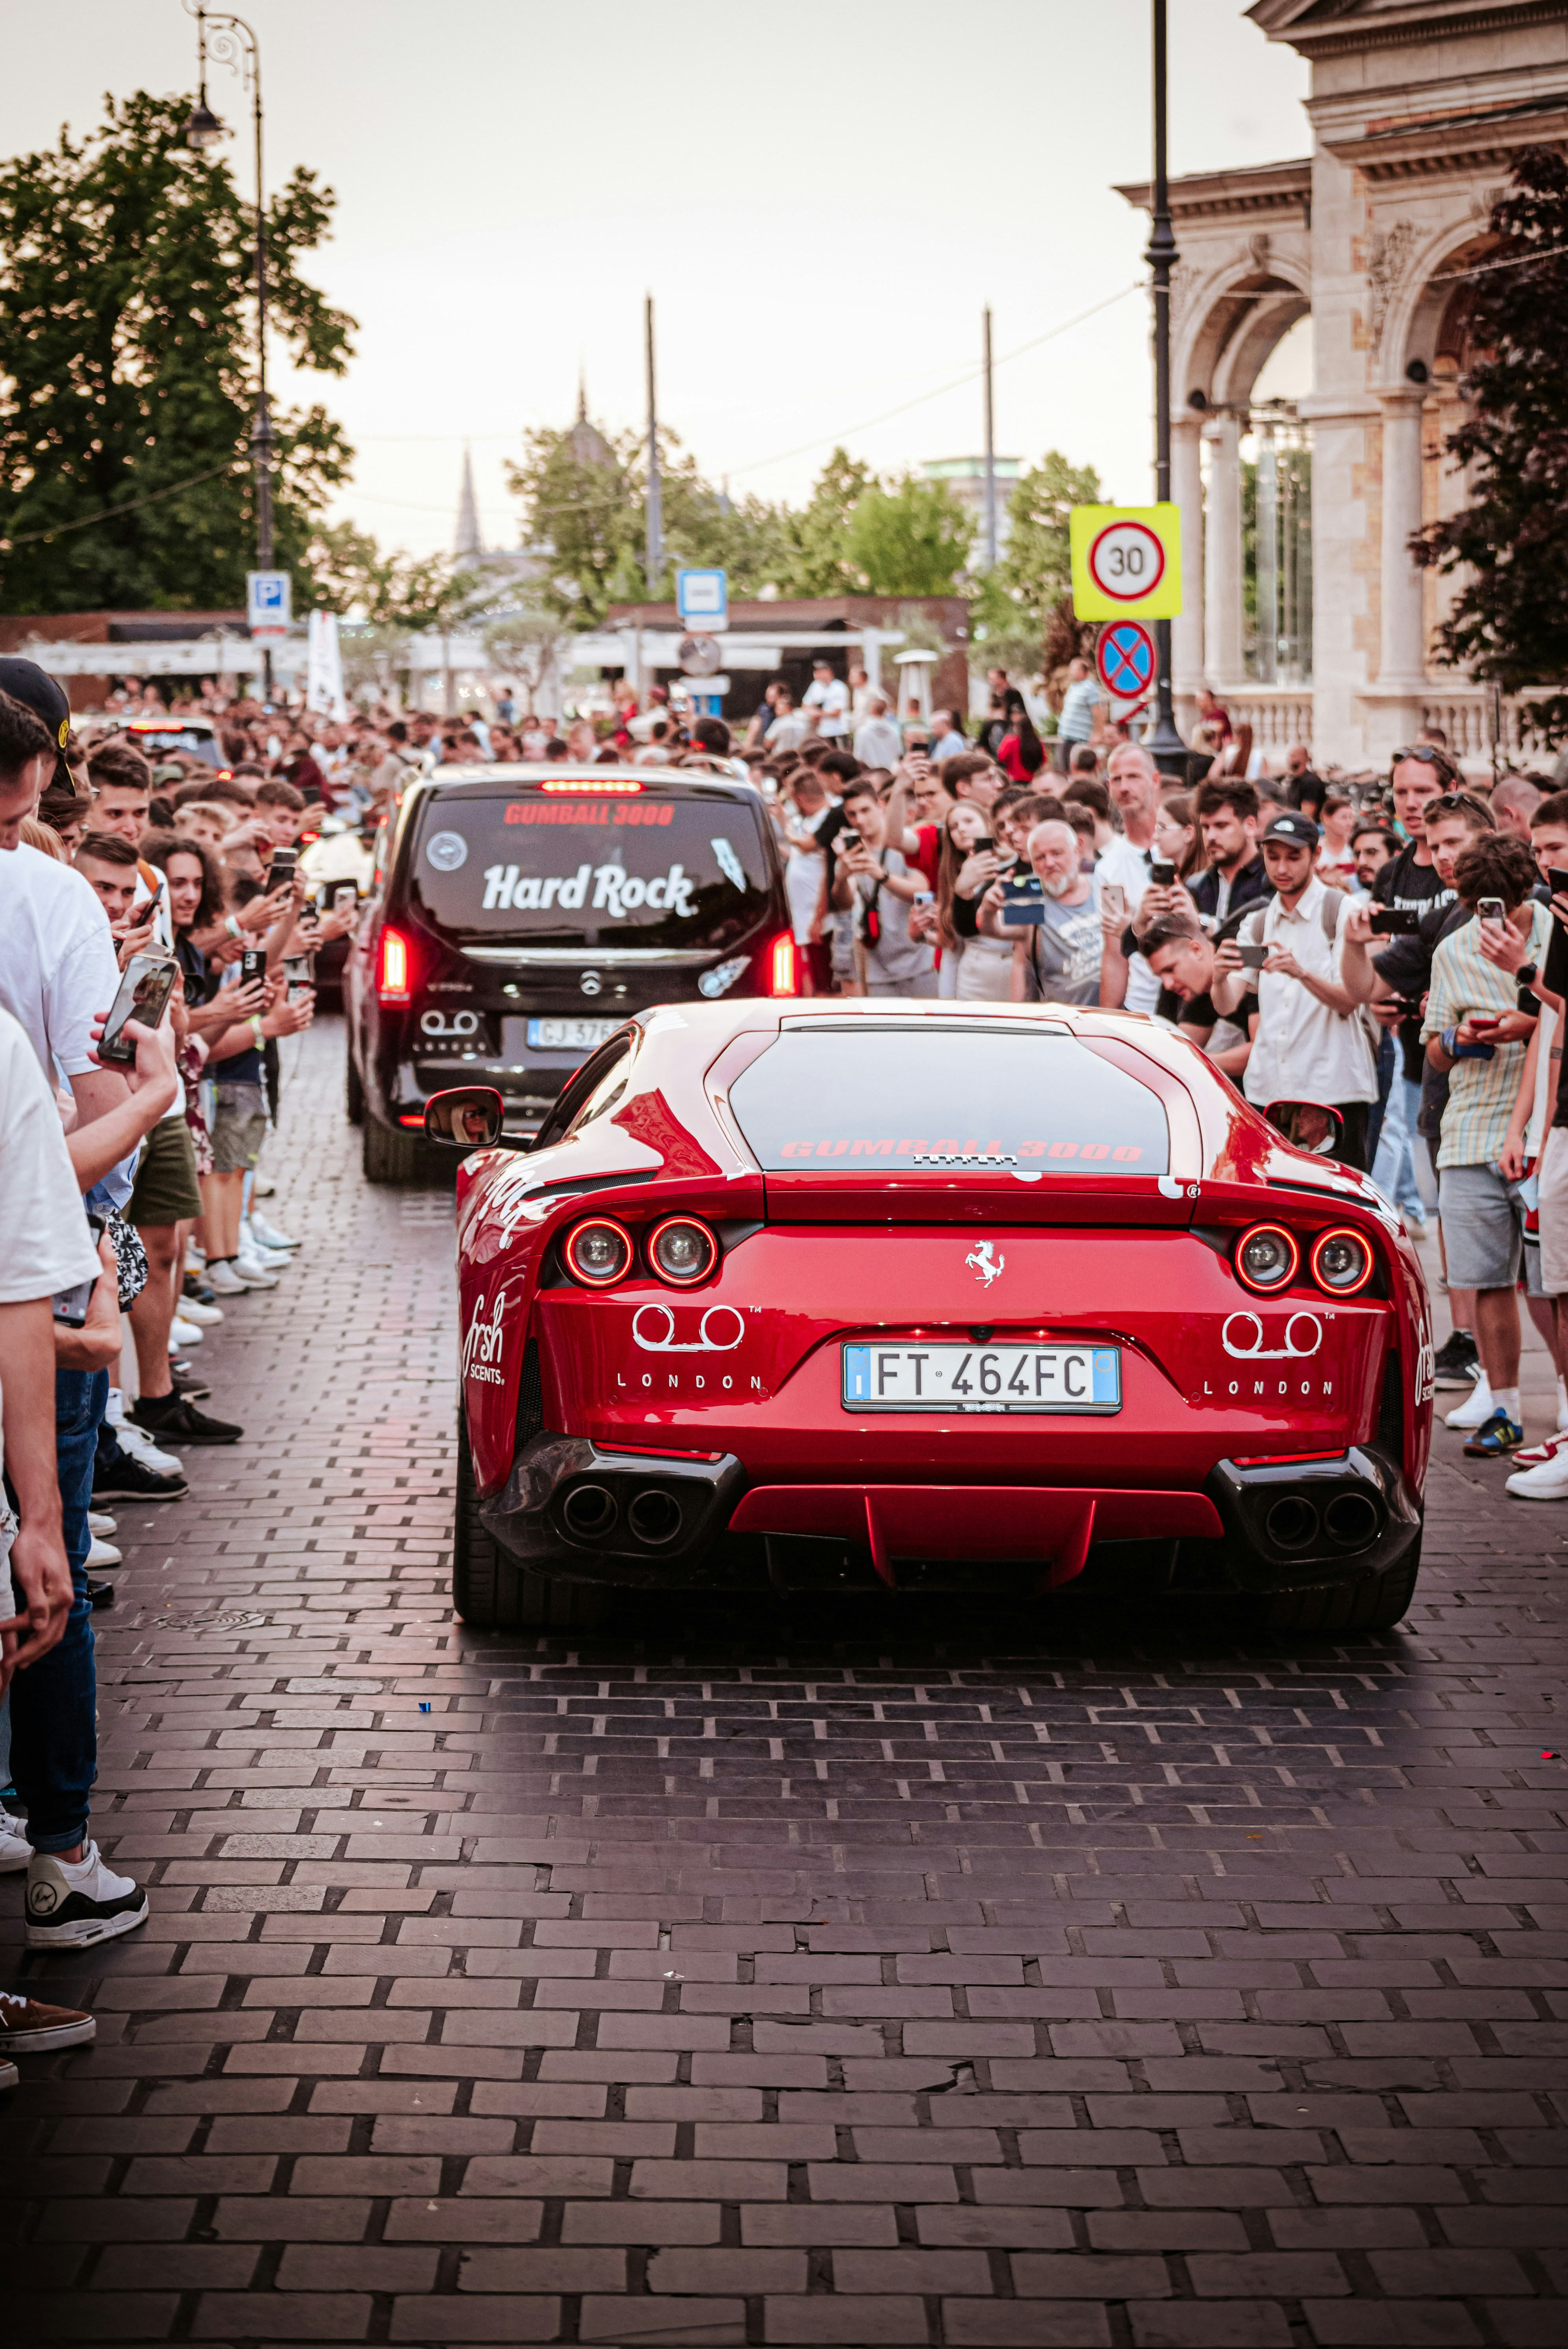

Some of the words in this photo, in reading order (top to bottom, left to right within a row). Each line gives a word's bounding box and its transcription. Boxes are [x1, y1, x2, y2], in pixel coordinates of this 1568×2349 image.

[1109, 547, 1143, 576] 30
[504, 804, 608, 824] GUMBALL
[613, 804, 675, 825] 3000
[482, 864, 591, 909] Hard
[592, 864, 694, 917] Rock
[575, 1023, 621, 1043] 376
[780, 1139, 1006, 1158] GUMBALL
[1017, 1140, 1143, 1162] 3000
[914, 1154, 1017, 1164] Ferrari
[617, 1373, 761, 1389] LONDON
[878, 1353, 929, 1395] FT
[951, 1353, 1085, 1397] 464FC
[1204, 1381, 1333, 1395] LONDON
